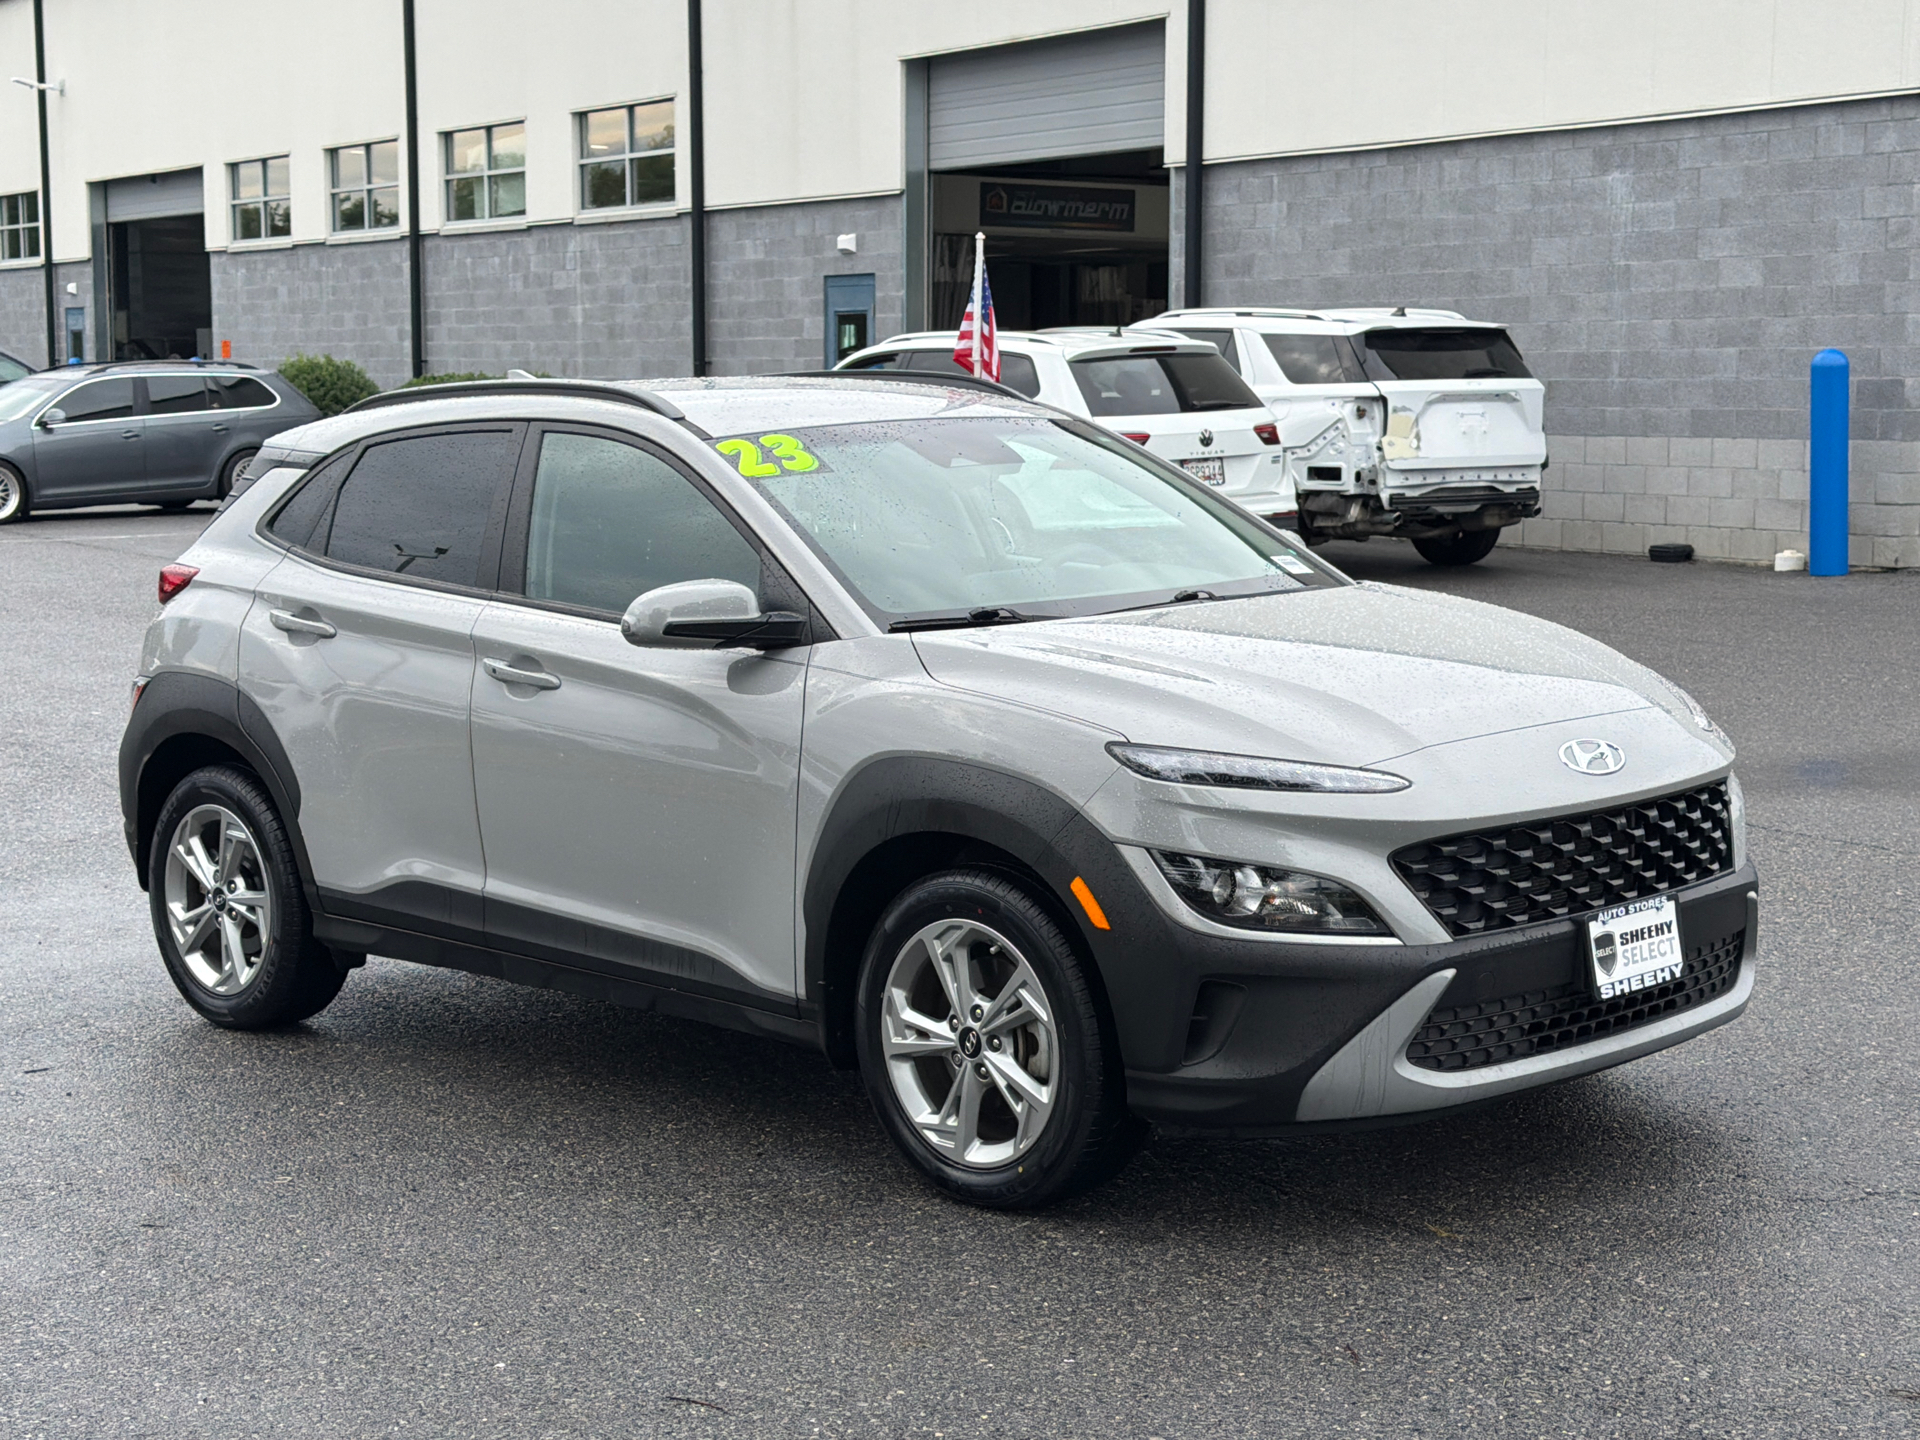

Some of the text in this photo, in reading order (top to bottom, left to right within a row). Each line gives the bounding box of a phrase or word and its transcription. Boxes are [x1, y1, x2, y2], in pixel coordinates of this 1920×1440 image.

[715, 433, 819, 477] 23
[1597, 896, 1668, 922] AUTO STORES
[1619, 920, 1673, 946] SHEEHY
[1595, 945, 1616, 958] SELECT
[1622, 936, 1676, 967] SELECT
[1600, 962, 1683, 999] SHEEHY
